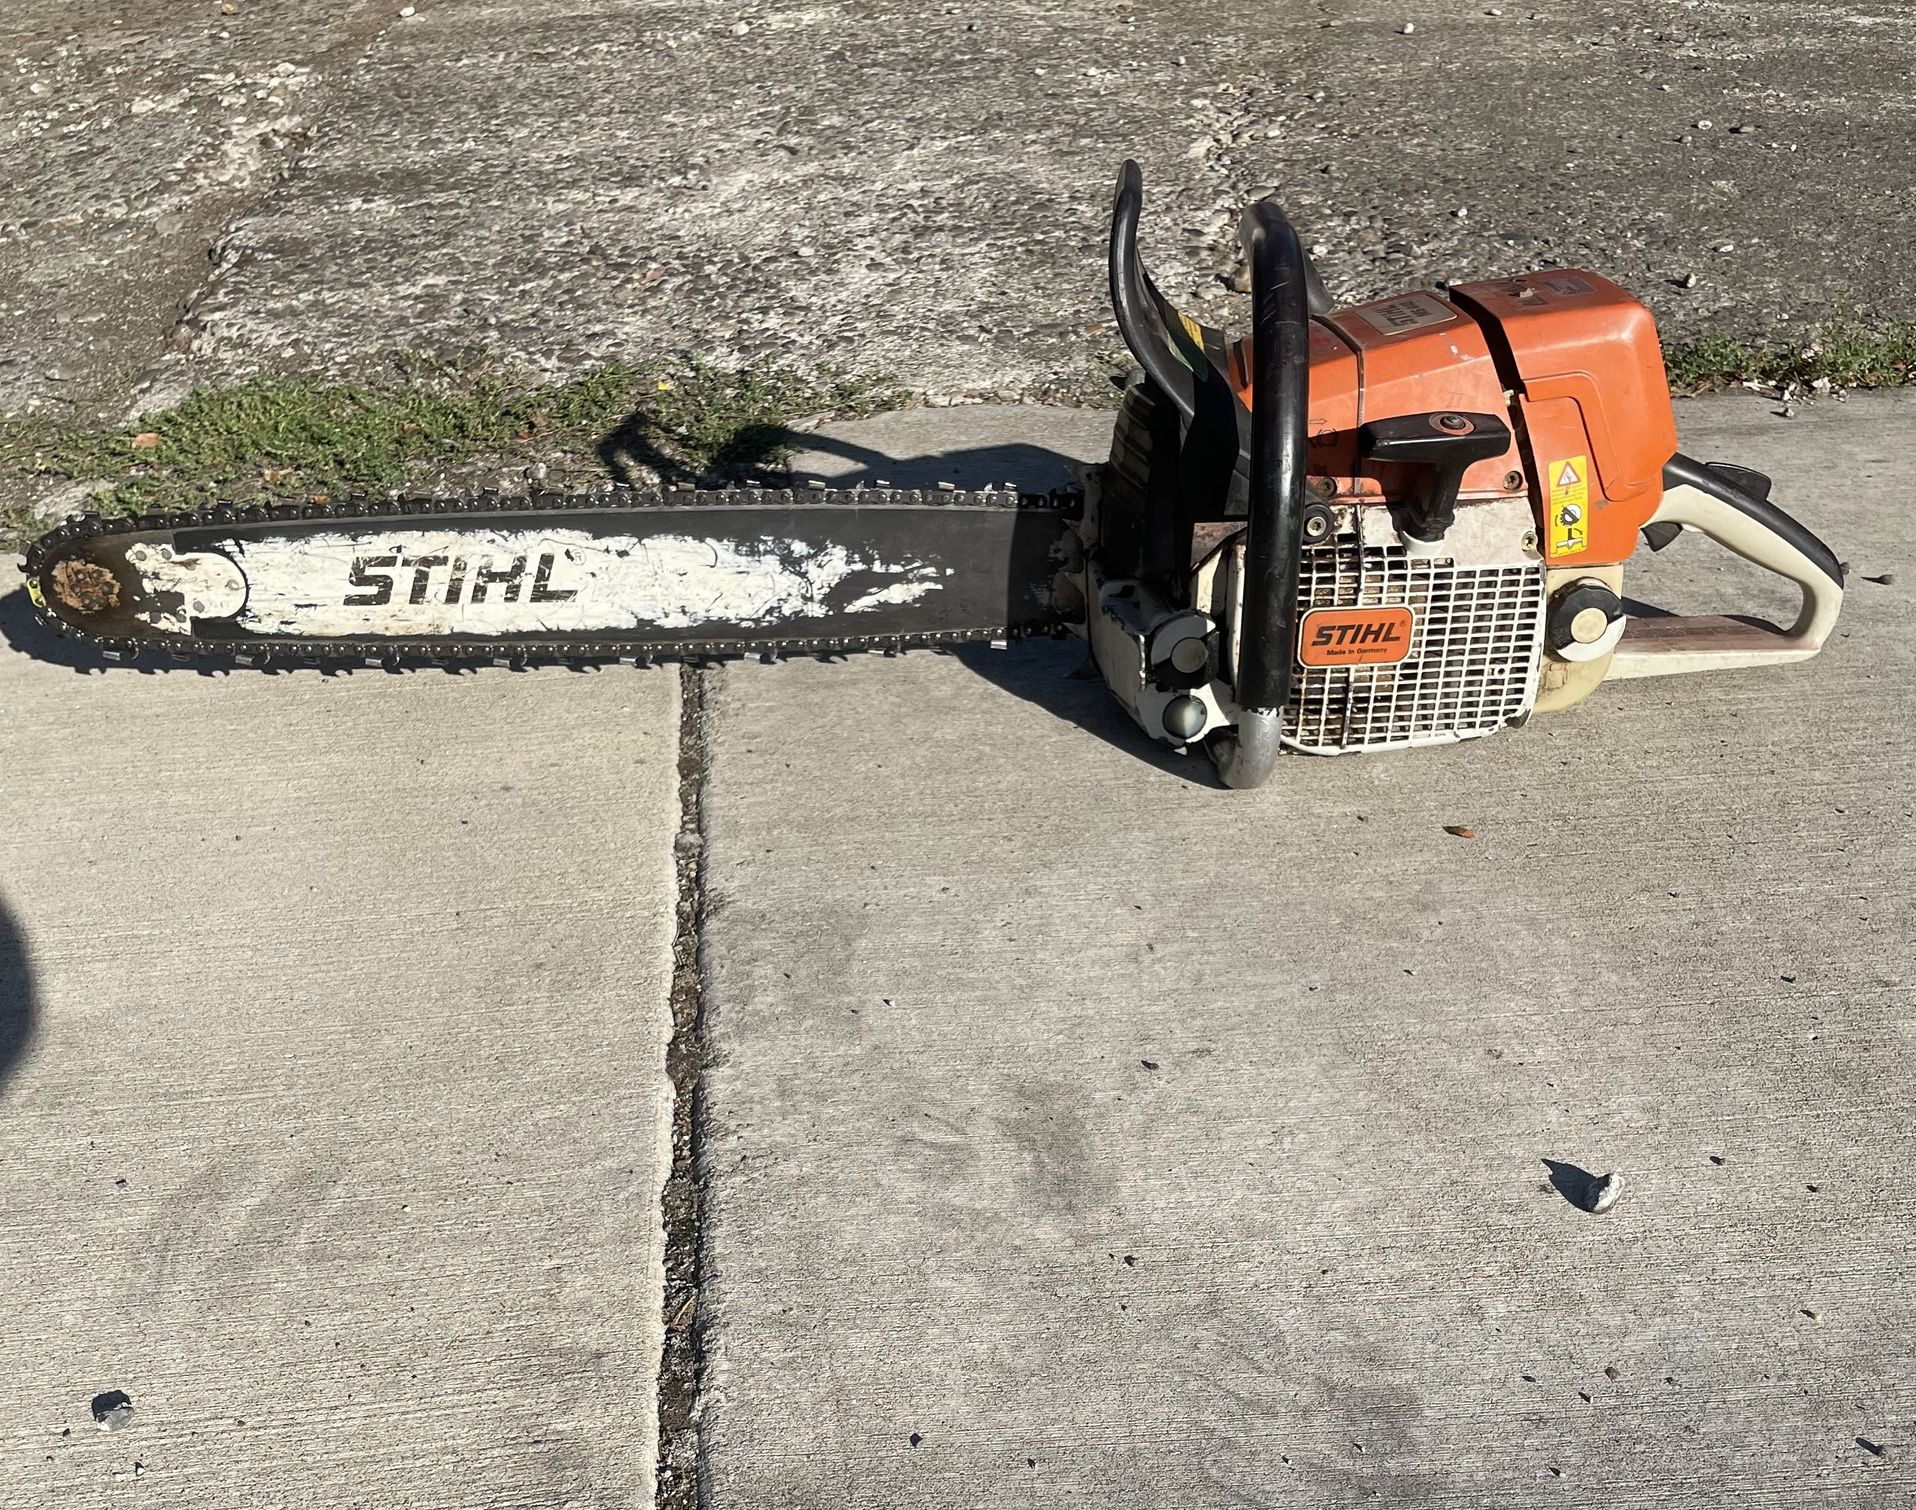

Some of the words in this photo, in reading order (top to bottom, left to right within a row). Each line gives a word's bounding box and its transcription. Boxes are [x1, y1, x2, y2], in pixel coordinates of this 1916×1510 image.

[343, 553, 579, 605] STIHL
[1312, 622, 1401, 646] STIHL
[1326, 648, 1346, 656] Made
[1356, 647, 1388, 656] Germany
